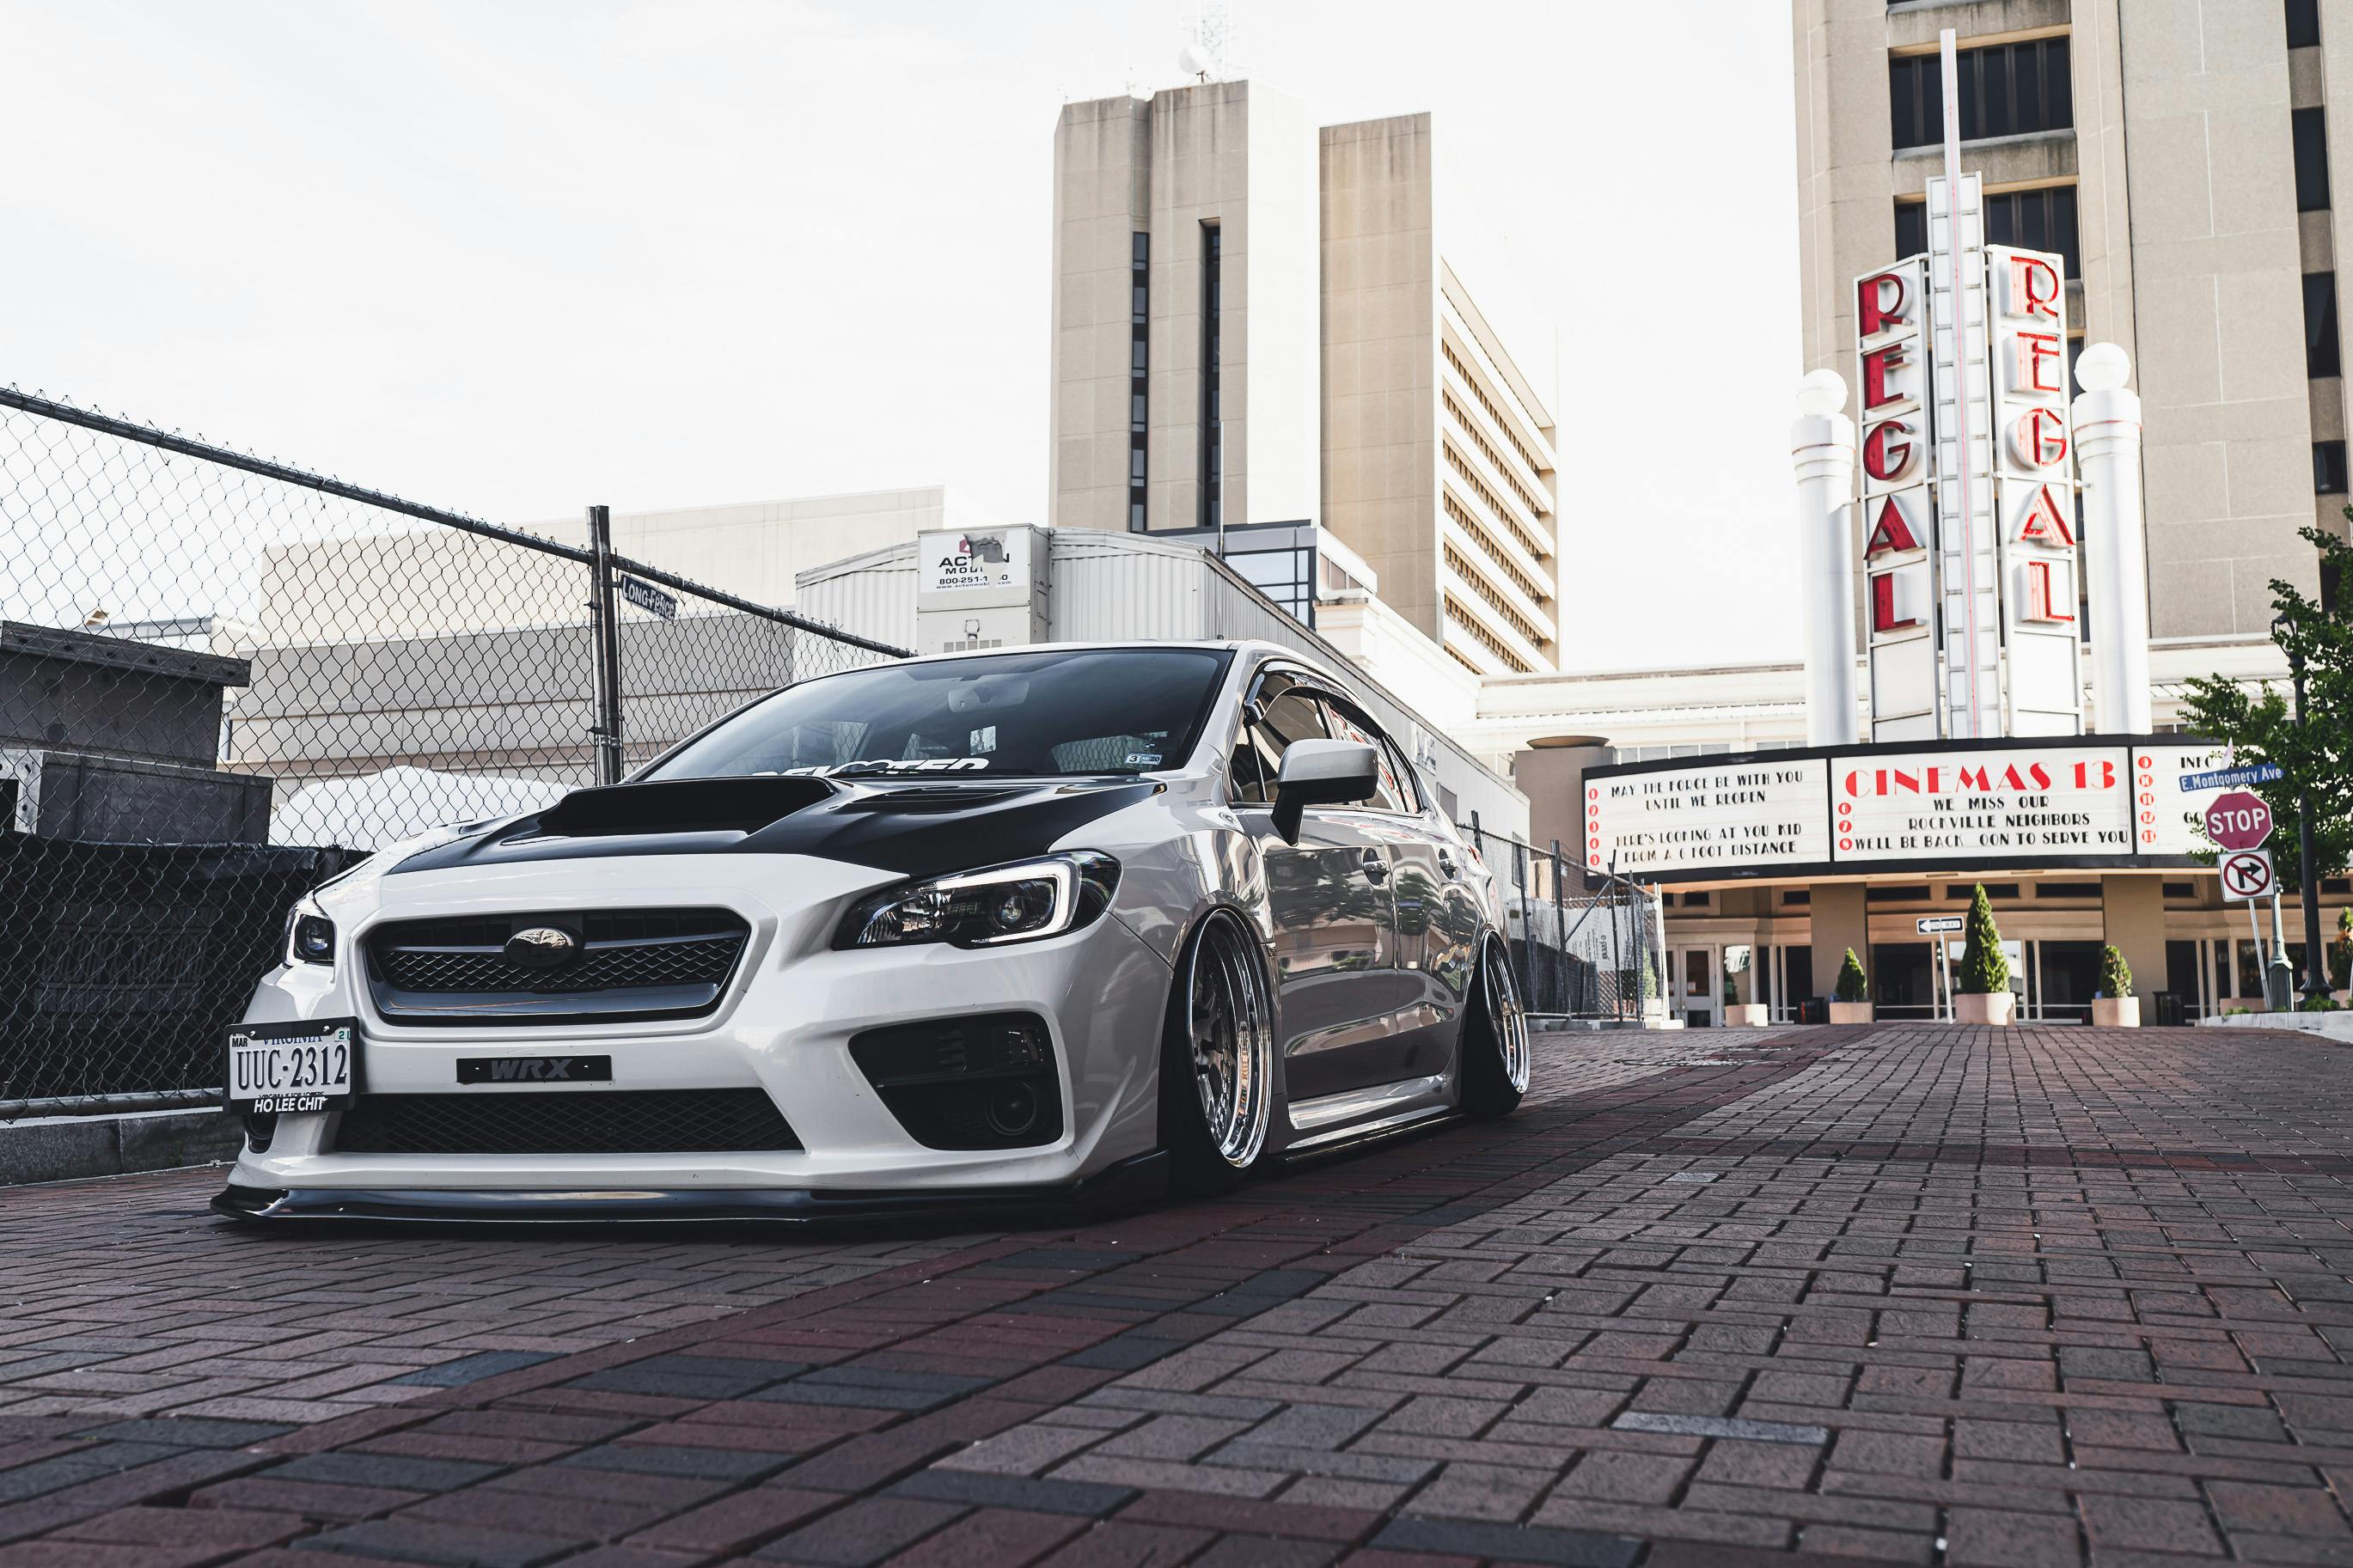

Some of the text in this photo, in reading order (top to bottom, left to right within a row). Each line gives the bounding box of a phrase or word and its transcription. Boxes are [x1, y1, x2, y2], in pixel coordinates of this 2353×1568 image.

[2005, 256, 2075, 623] REGAL
[1858, 273, 1922, 632] REGAL
[939, 574, 1008, 585] 800-251-10
[623, 577, 648, 607] LONG
[1611, 772, 1803, 797] MAY THE FORCE BE WITH YOU
[1845, 760, 2116, 797] CINEMAS 13
[2261, 767, 2283, 781] Ave
[1646, 790, 1765, 810] UNTIL WE REOPEN
[1934, 796, 2050, 811] WE MISS OUR
[1909, 813, 2090, 830] ROCKVILLE NEIGHBORS
[2210, 808, 2266, 835] STOP
[1617, 824, 1801, 846] HERE'S LOOKING AT YOU KID
[1855, 837, 1892, 850] WELL
[1900, 836, 1917, 849] BE
[1924, 835, 1964, 847] BACK
[2016, 832, 2036, 845] TO
[2042, 831, 2090, 845] SERVE
[2099, 831, 2129, 844] YOU
[1624, 850, 1656, 863] FROM
[1664, 849, 1672, 860] A
[1692, 845, 1722, 858] FOOT
[1732, 841, 1796, 856] DISTANCE
[232, 1038, 248, 1047] MAR
[491, 1059, 572, 1080] WRX
[254, 1096, 327, 1113] HO LEE CHIT
